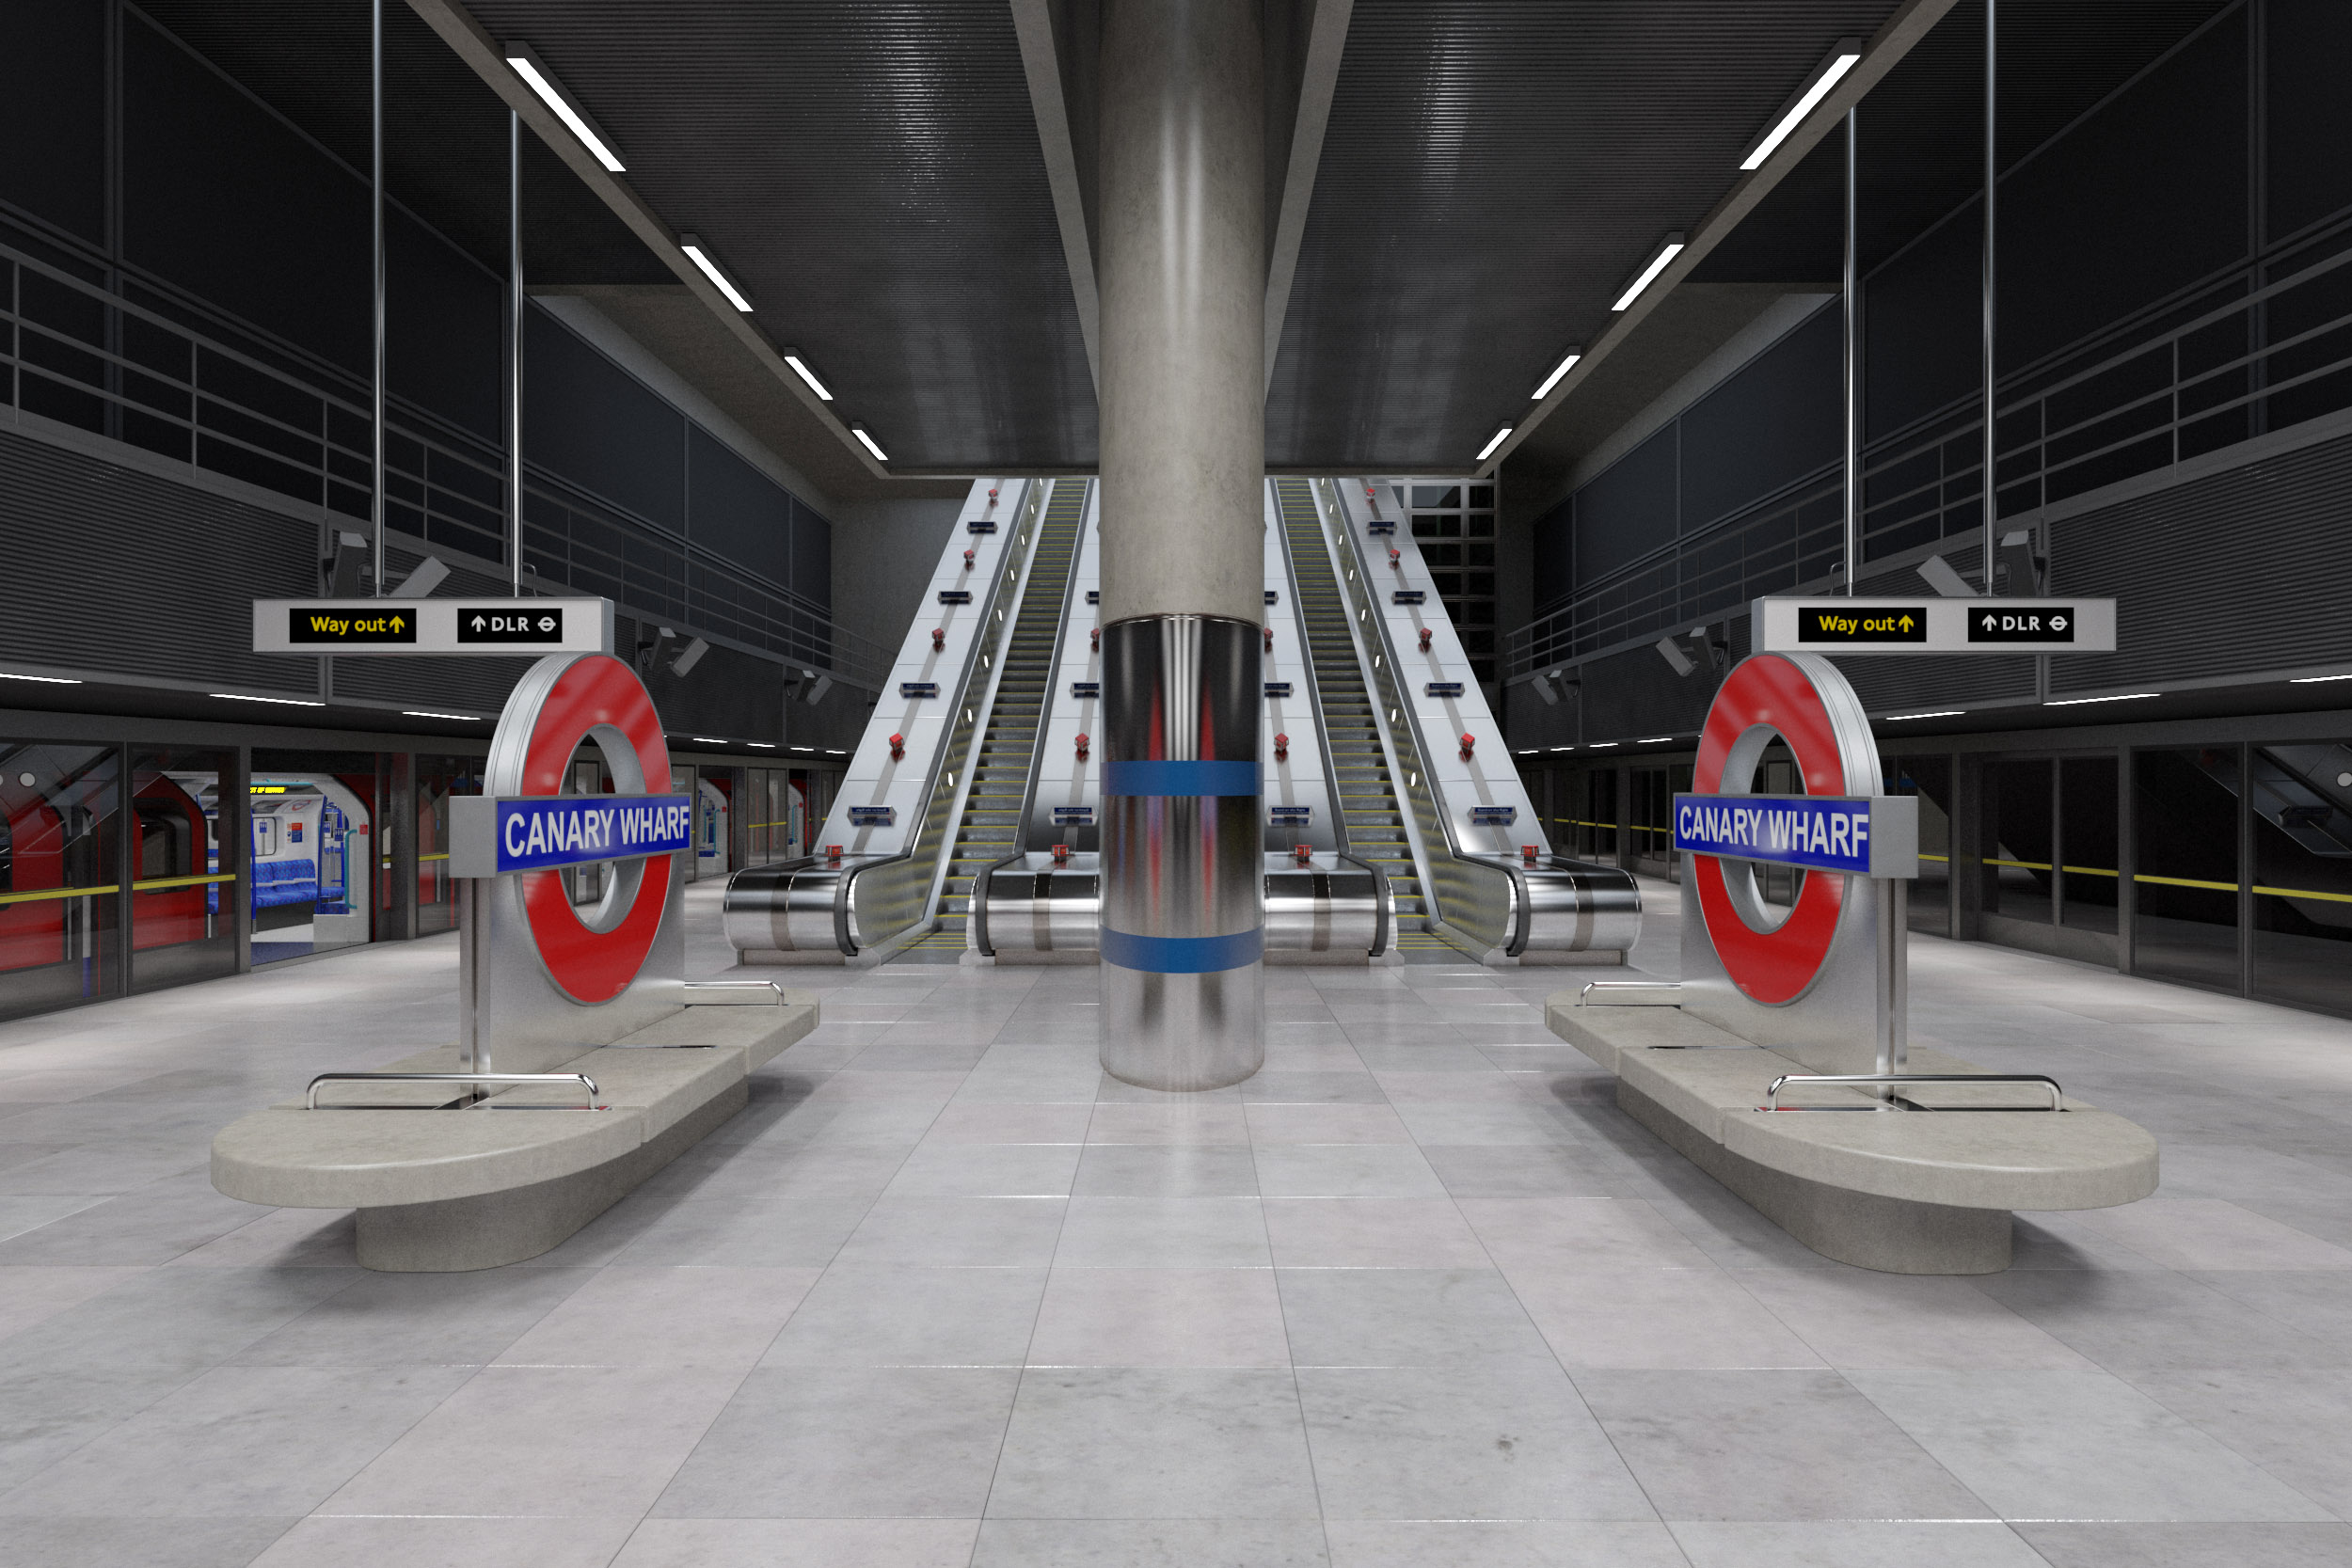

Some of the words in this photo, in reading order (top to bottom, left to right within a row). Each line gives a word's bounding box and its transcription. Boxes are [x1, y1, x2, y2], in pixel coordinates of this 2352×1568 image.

[310, 616, 349, 635] Way
[355, 617, 387, 632] out
[491, 616, 530, 632] DLR
[1819, 615, 1859, 635] Way
[1864, 616, 1896, 631] out
[2002, 615, 2041, 631] DLR
[505, 809, 615, 857] CANARY
[619, 806, 690, 845] WHARF
[1679, 805, 1763, 847] CANARY
[1768, 810, 1869, 857] WHARF
